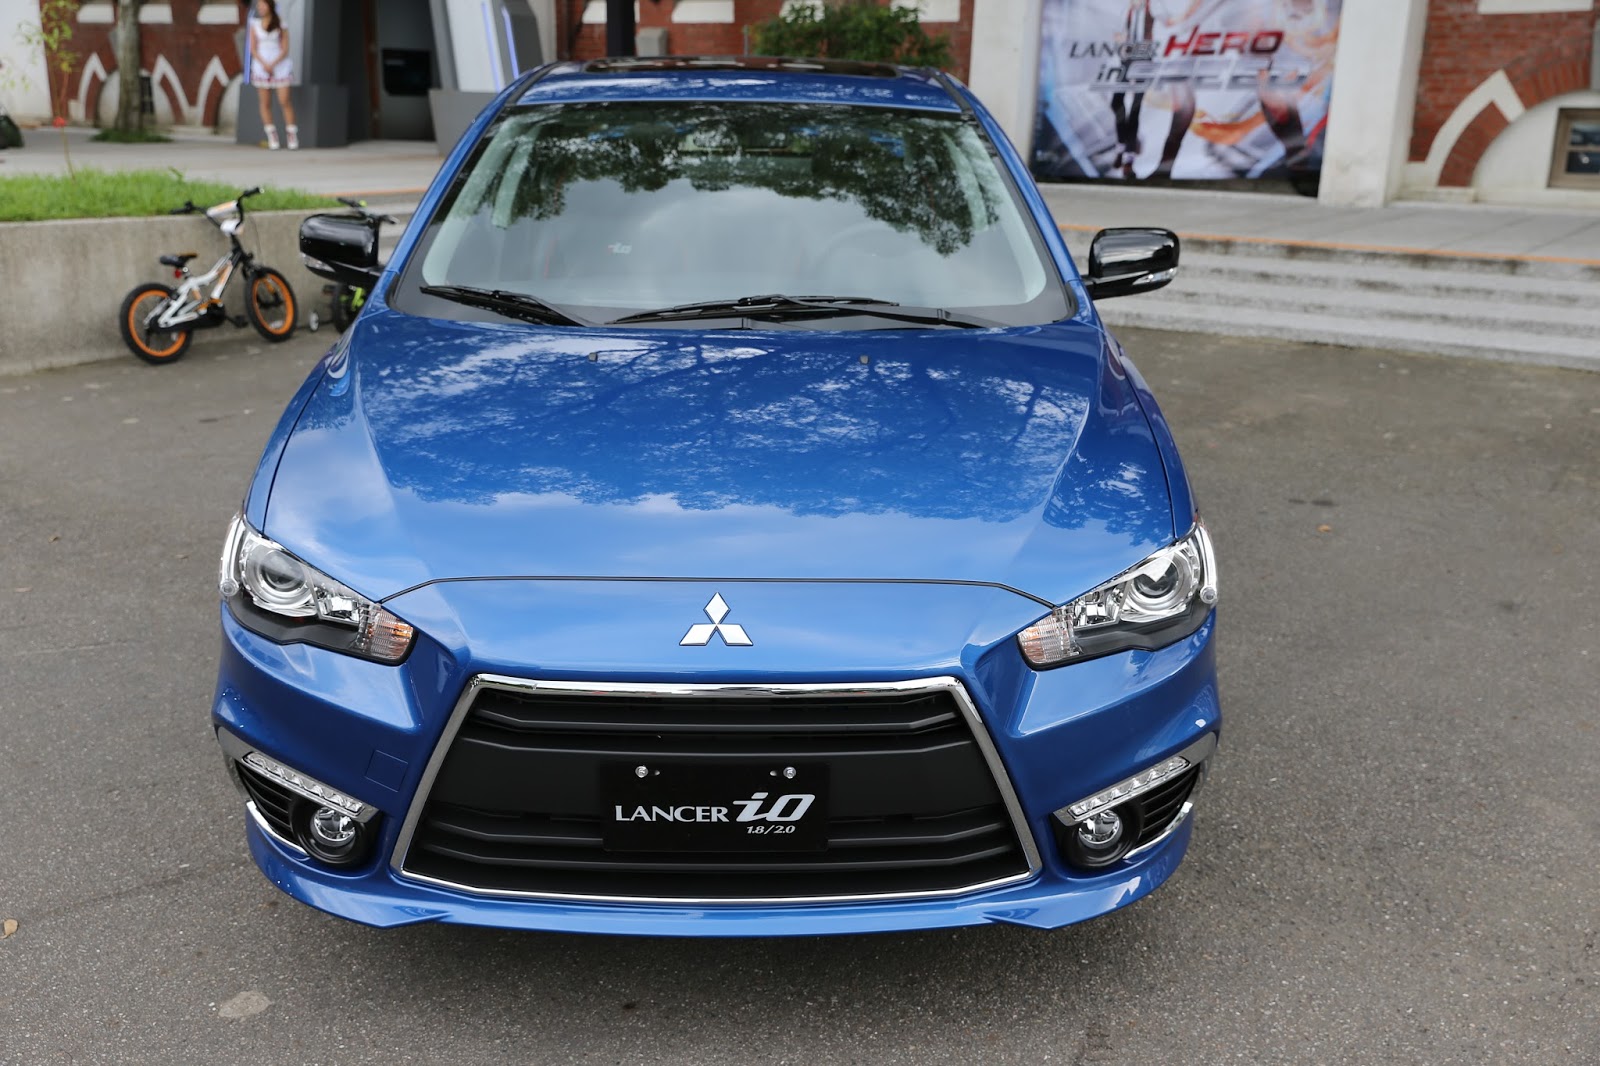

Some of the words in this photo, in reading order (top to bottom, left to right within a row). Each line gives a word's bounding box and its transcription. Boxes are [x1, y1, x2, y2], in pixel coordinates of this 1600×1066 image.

[1070, 40, 1159, 59] LANCER
[1163, 26, 1284, 57] HERO
[615, 805, 730, 823] LANCER
[747, 825, 796, 835] 1.8/2.0
